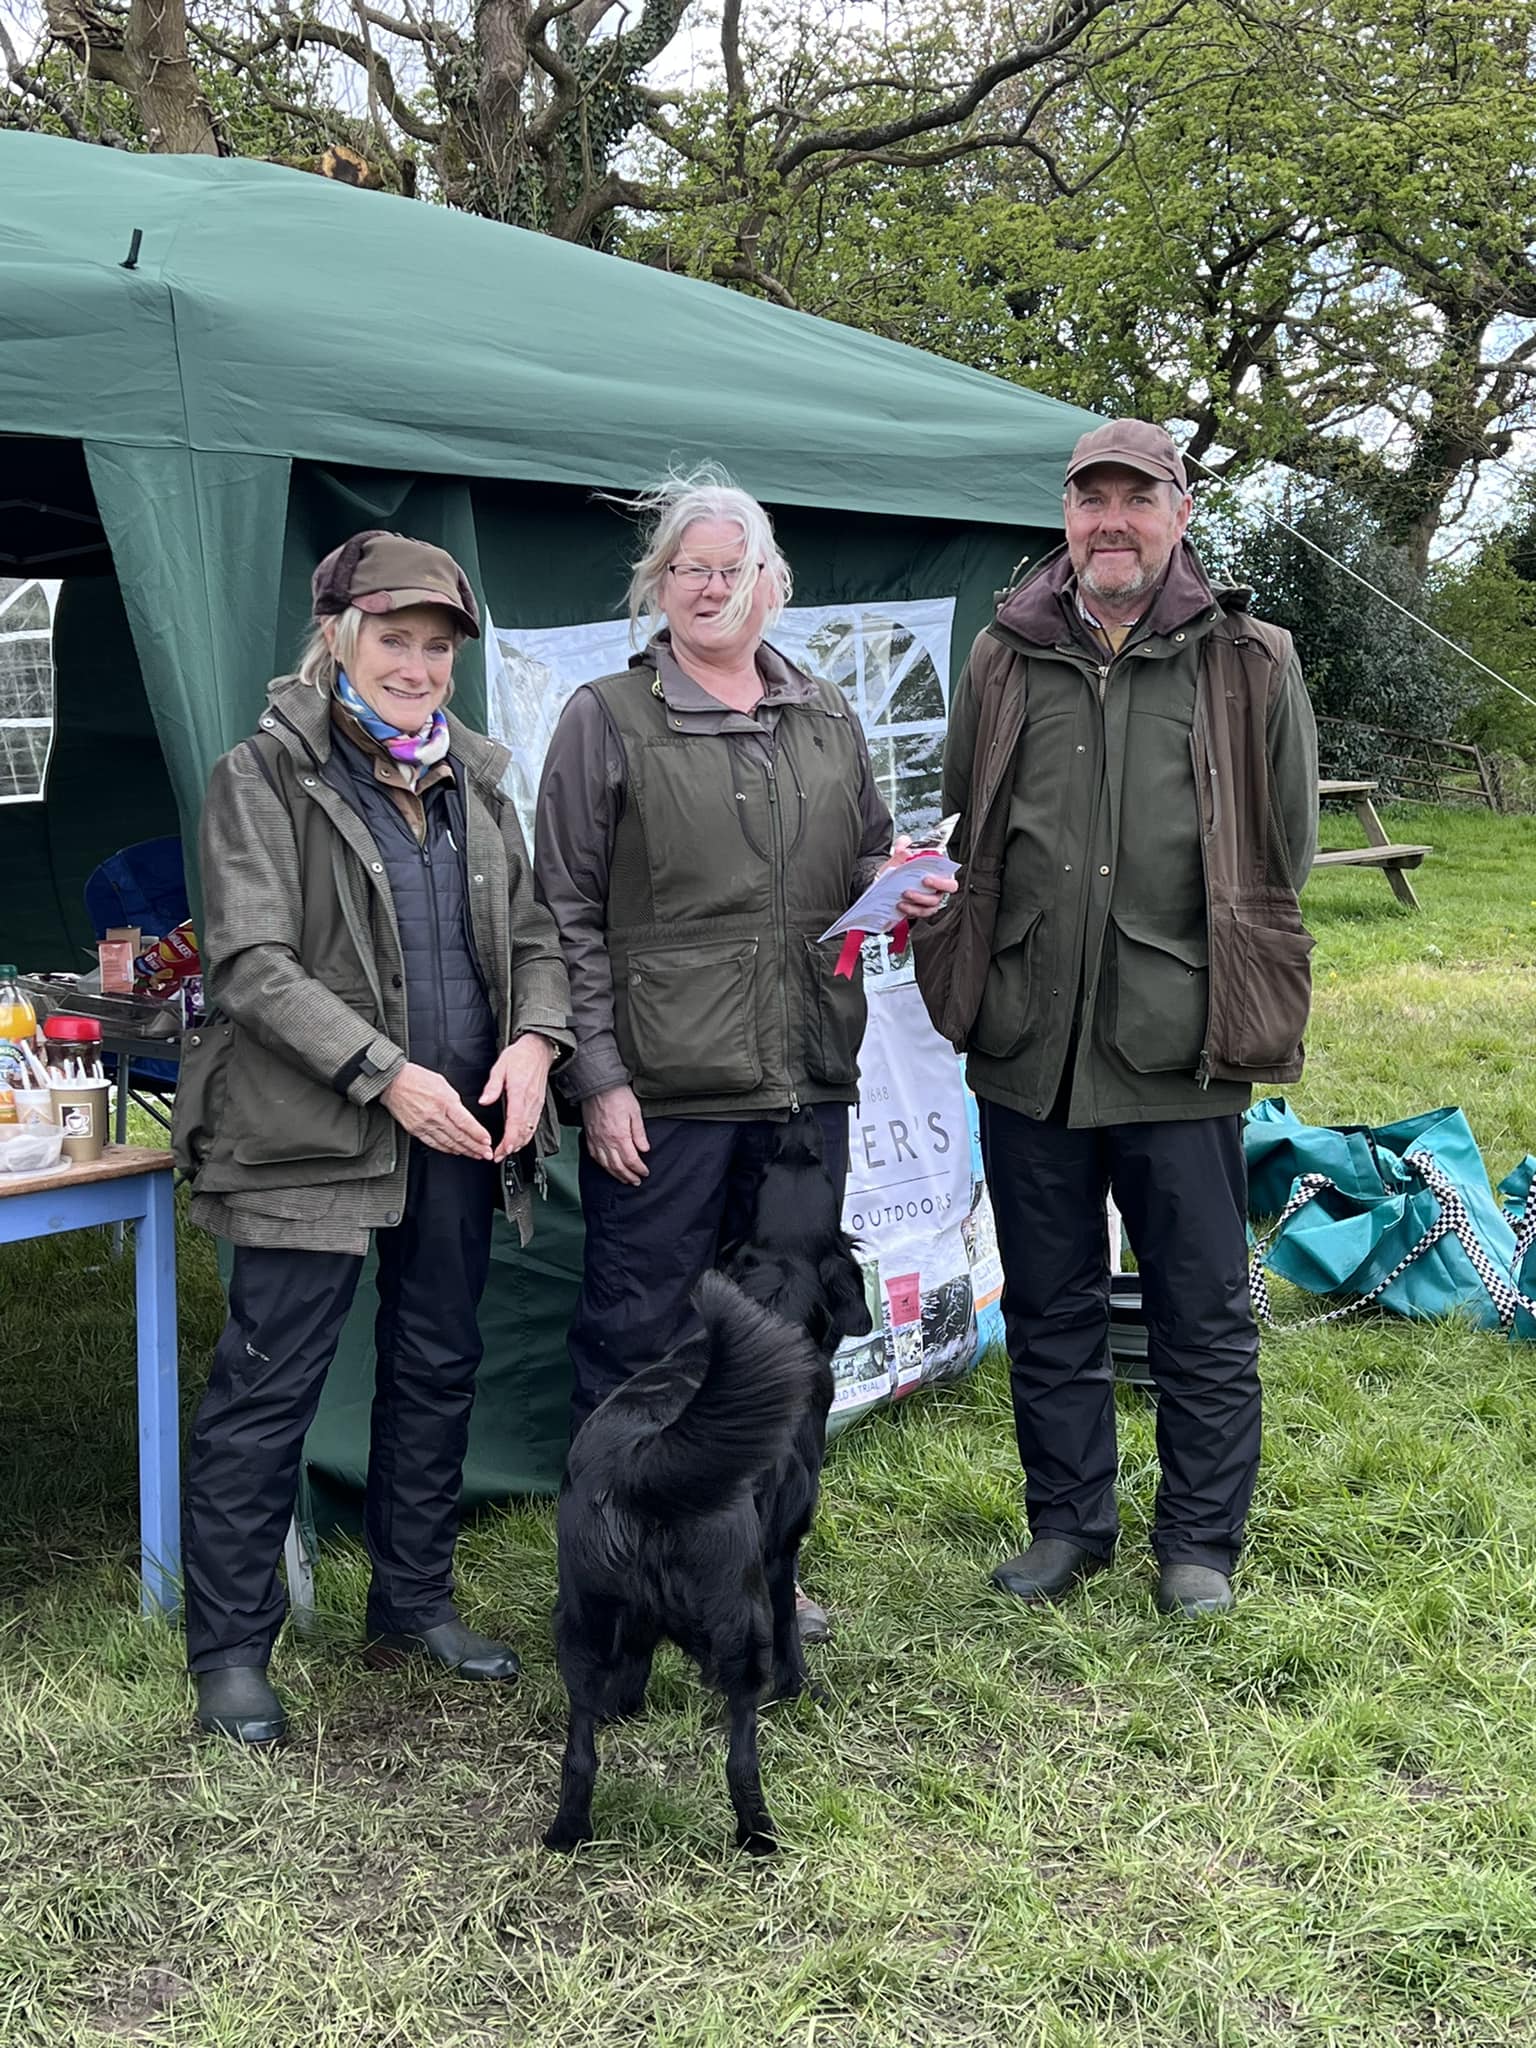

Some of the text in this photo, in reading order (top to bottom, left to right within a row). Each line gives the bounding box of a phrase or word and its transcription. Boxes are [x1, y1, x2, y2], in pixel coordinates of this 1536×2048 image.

[847, 1111, 950, 1173] ER'S
[851, 1193, 952, 1231] OUTDOORS
[858, 1380, 881, 1393] TRIAL
